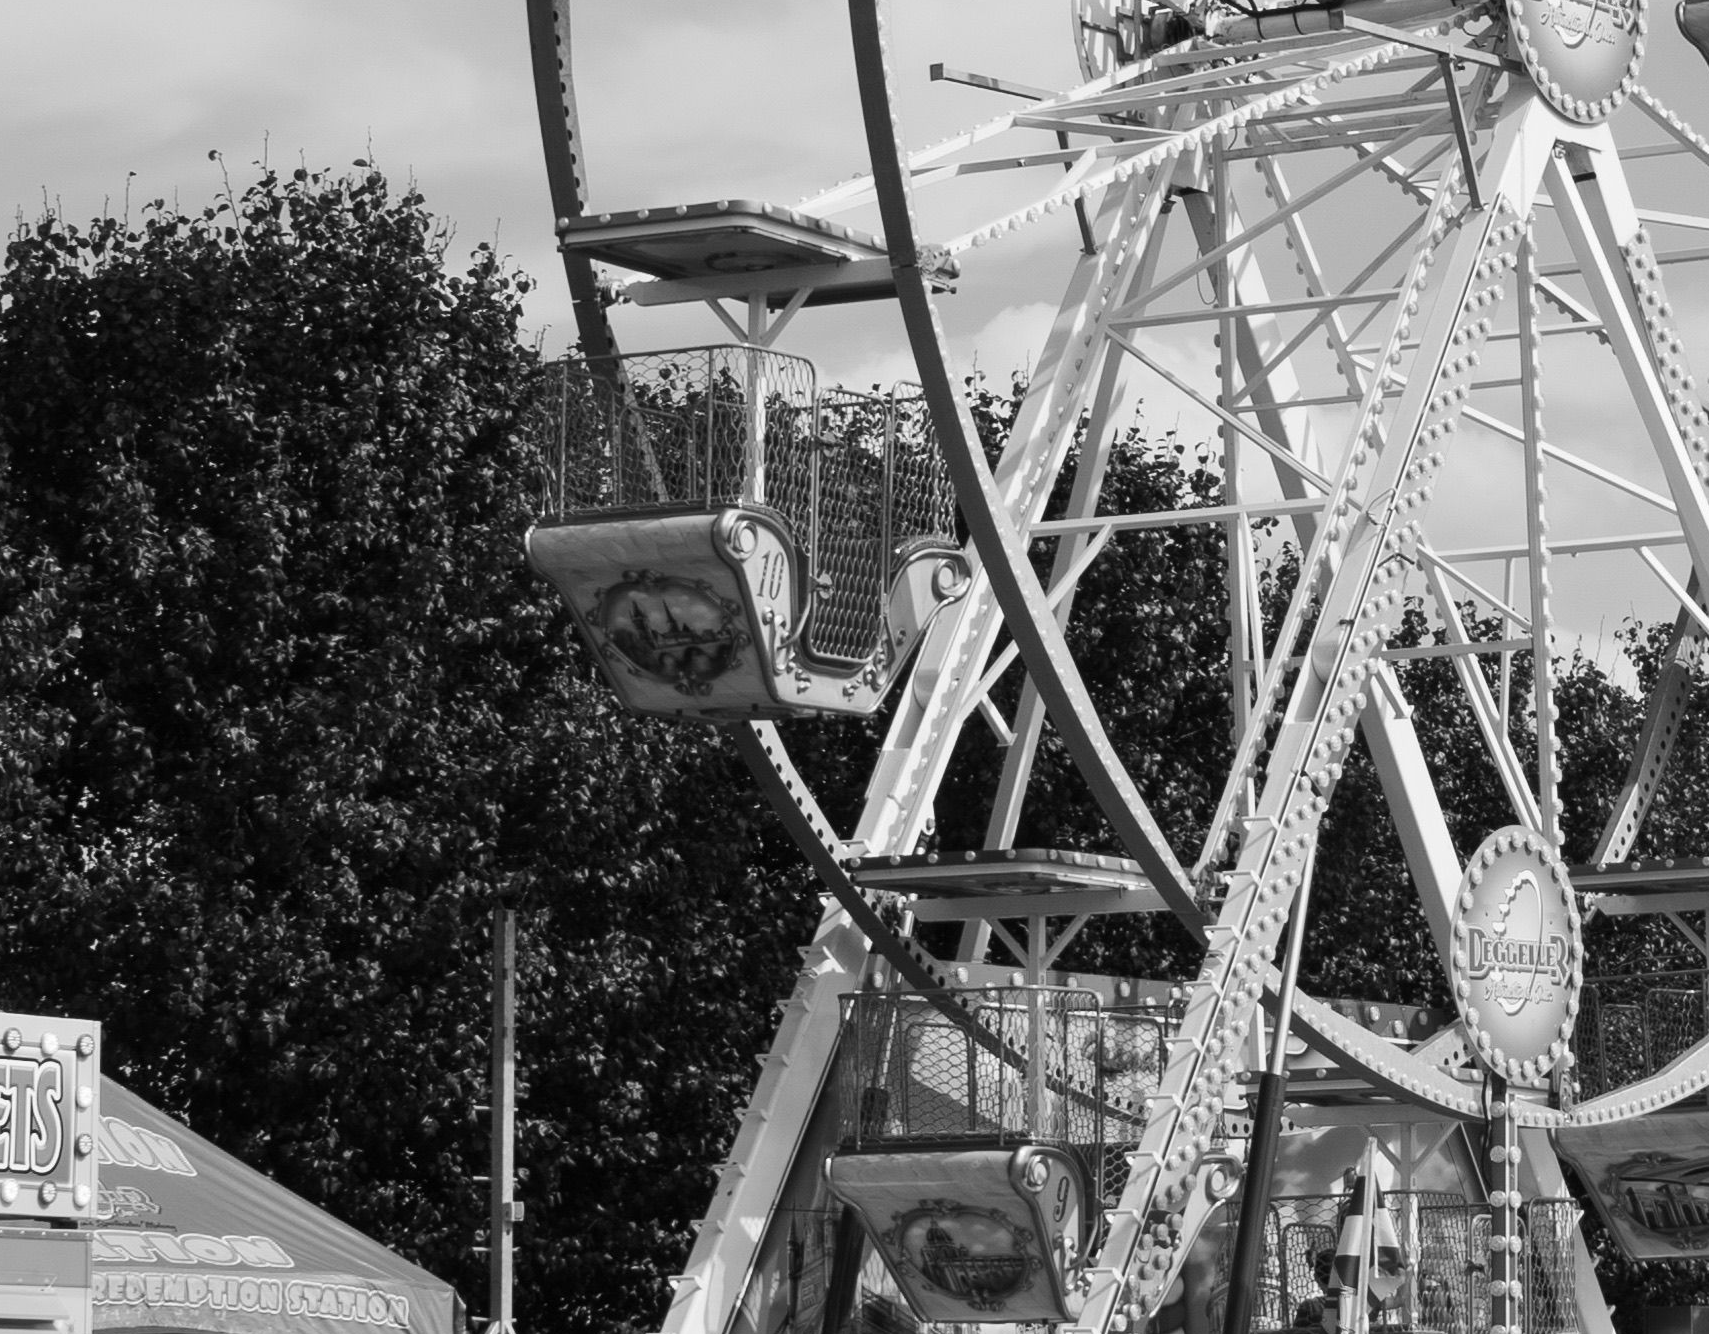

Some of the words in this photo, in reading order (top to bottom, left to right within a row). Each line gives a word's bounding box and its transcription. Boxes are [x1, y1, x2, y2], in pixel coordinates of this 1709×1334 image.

[756, 550, 785, 601] 10
[1053, 1175, 1070, 1223] 9
[285, 1279, 410, 1329] STATION
